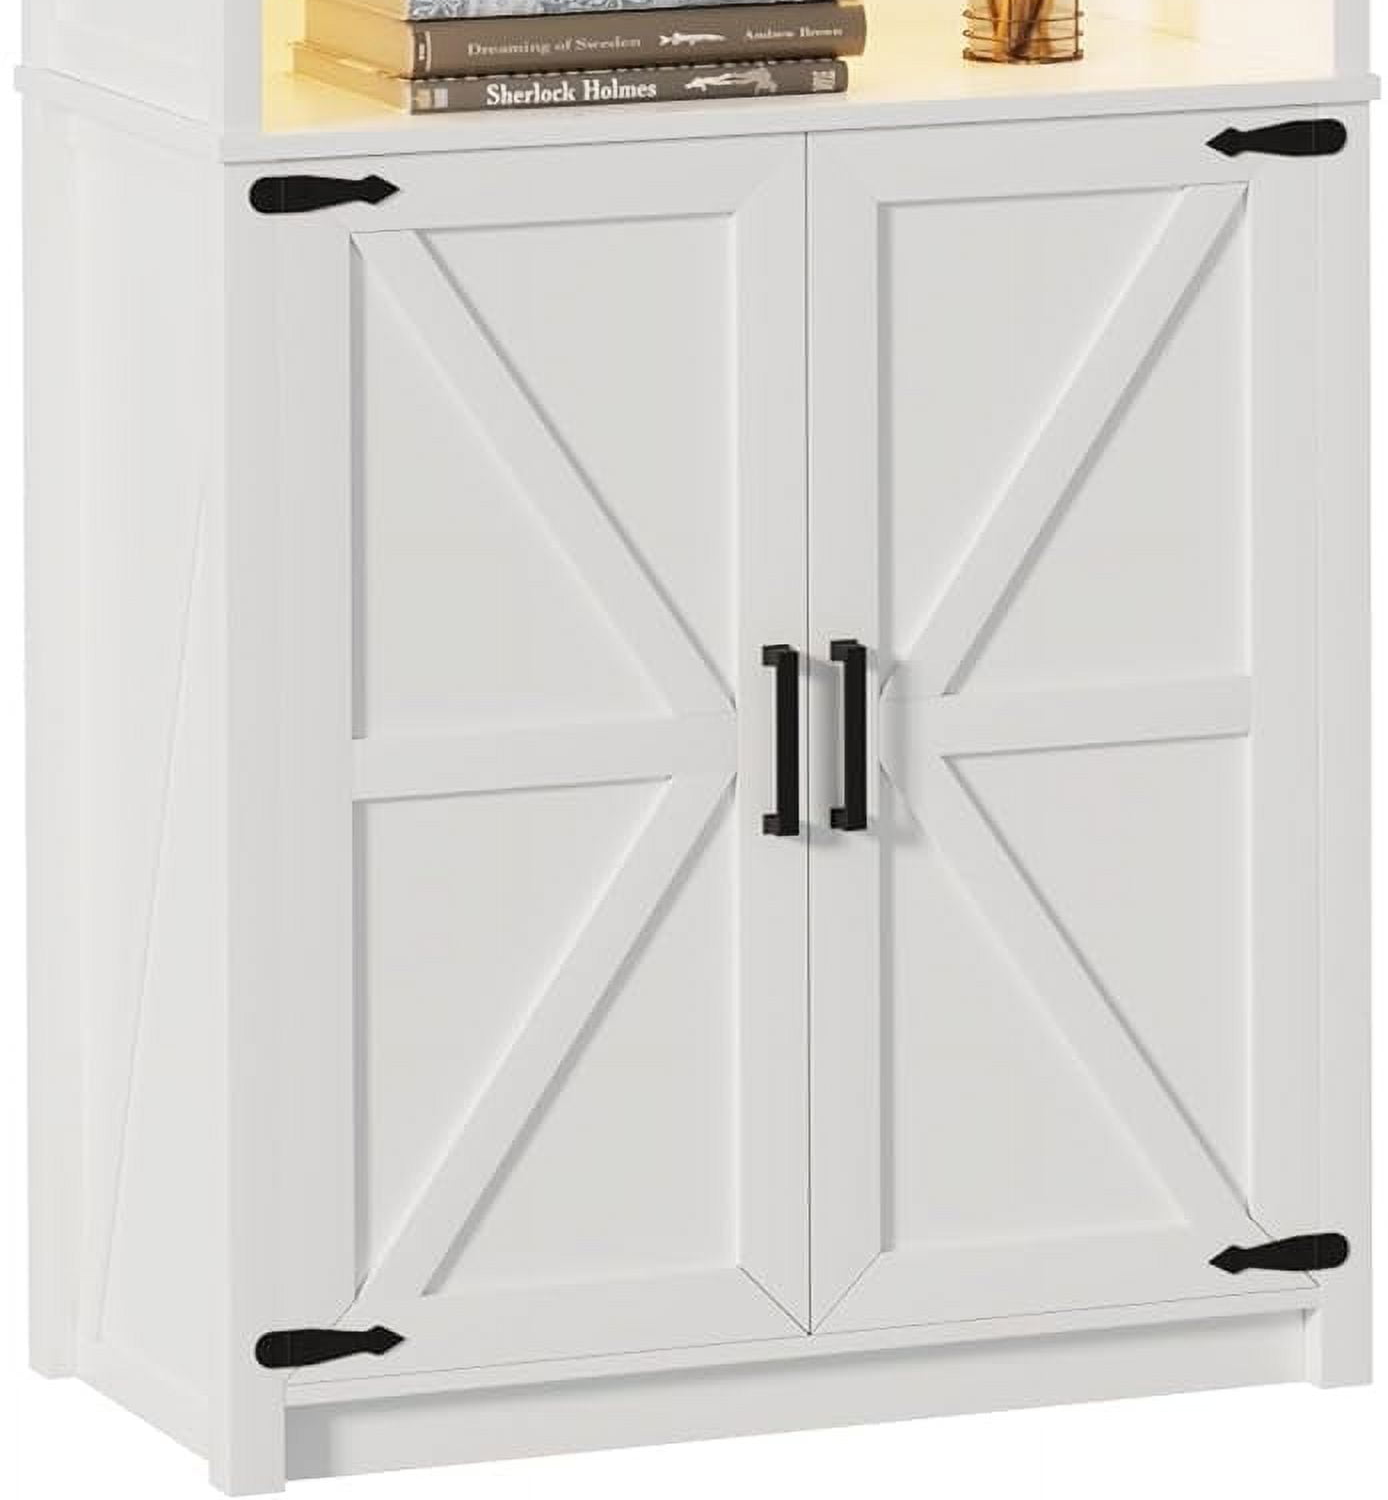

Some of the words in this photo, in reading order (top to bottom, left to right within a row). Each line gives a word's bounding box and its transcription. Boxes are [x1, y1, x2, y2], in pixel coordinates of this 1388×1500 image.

[467, 40, 550, 56] Dreaming
[555, 38, 573, 51] of
[575, 36, 641, 50] Sweden
[486, 80, 576, 106] Sherlock
[582, 77, 657, 102] Holmes
